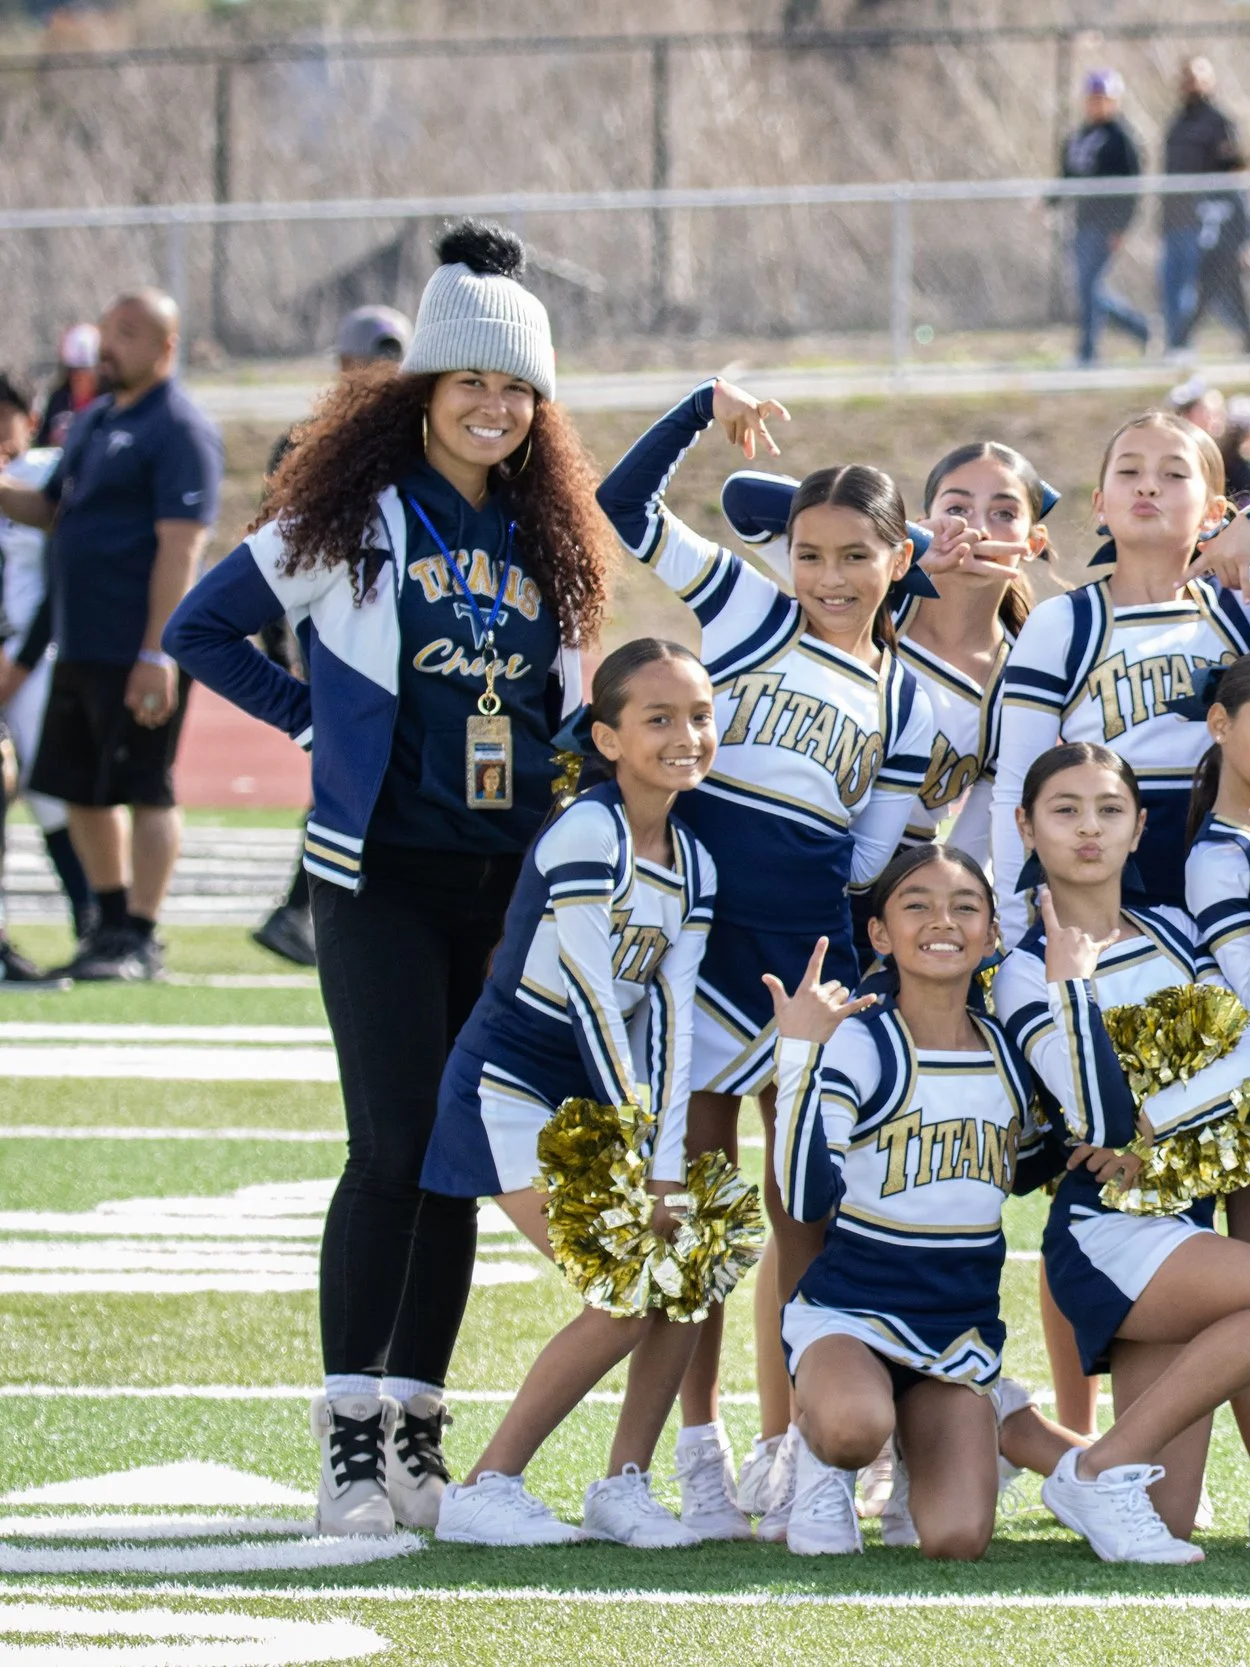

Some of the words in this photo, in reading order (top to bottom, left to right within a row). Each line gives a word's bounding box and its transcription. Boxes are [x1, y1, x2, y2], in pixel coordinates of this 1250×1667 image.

[720, 672, 884, 807] TITANS
[1087, 649, 1238, 744] TITA
[876, 1107, 1022, 1199] TITANS
